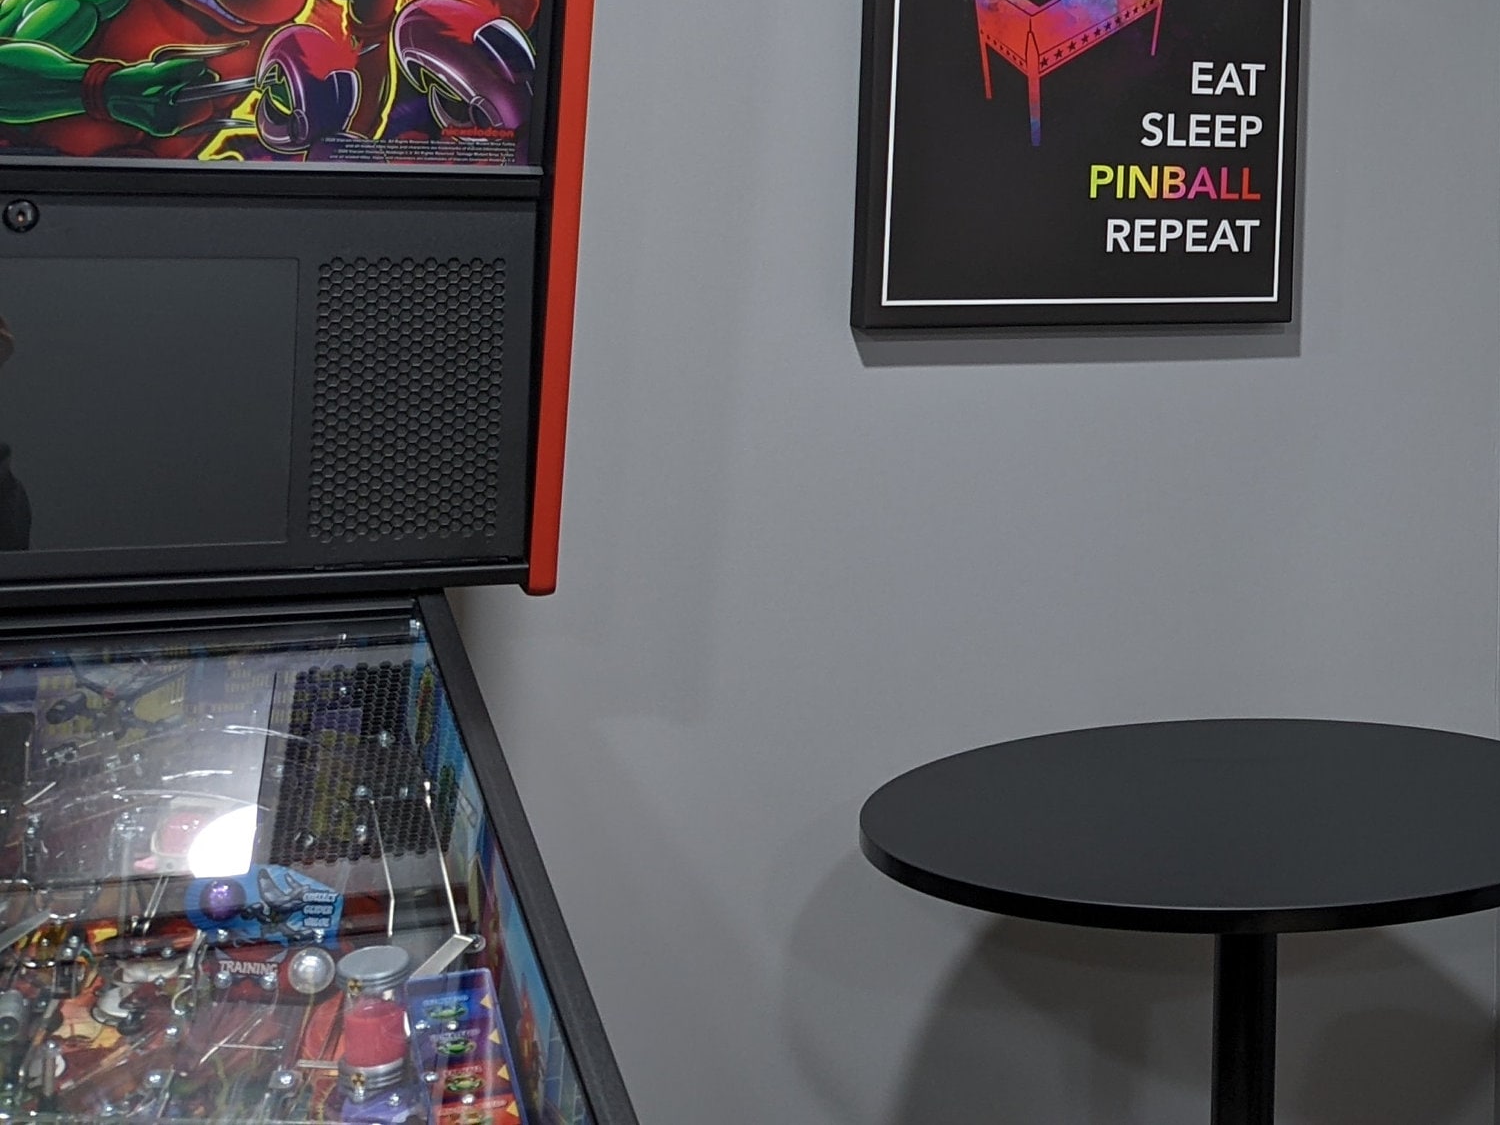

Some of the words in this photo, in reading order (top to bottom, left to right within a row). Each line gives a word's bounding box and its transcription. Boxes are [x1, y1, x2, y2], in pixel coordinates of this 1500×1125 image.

[1191, 61, 1266, 96] EAT
[1141, 113, 1262, 148] SLEEP
[1089, 165, 1261, 200] PINBALL
[1105, 219, 1260, 253] REPEAT
[218, 960, 279, 976] TRAINING
